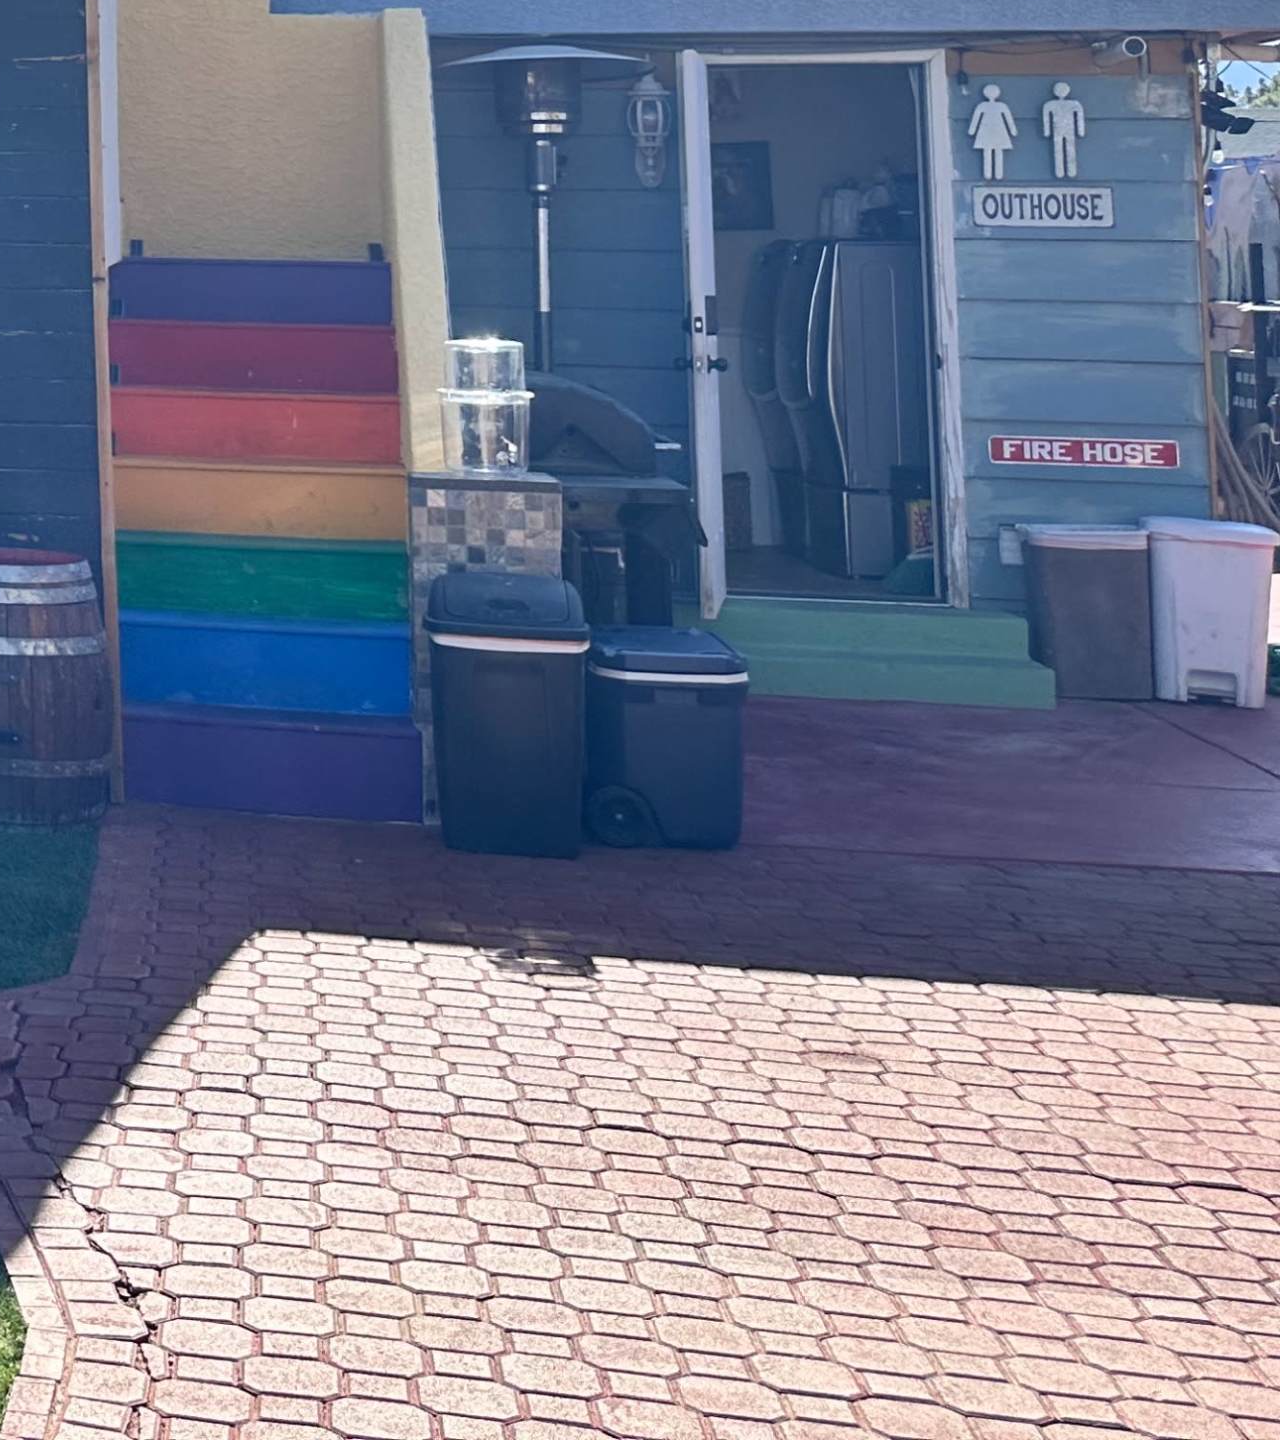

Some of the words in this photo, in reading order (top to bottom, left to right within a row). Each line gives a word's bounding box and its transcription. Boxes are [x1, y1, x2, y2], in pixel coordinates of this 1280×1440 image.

[981, 192, 1105, 222] OUTHOUSE
[1002, 439, 1073, 462] FIRE
[1082, 441, 1166, 465] HOSE
